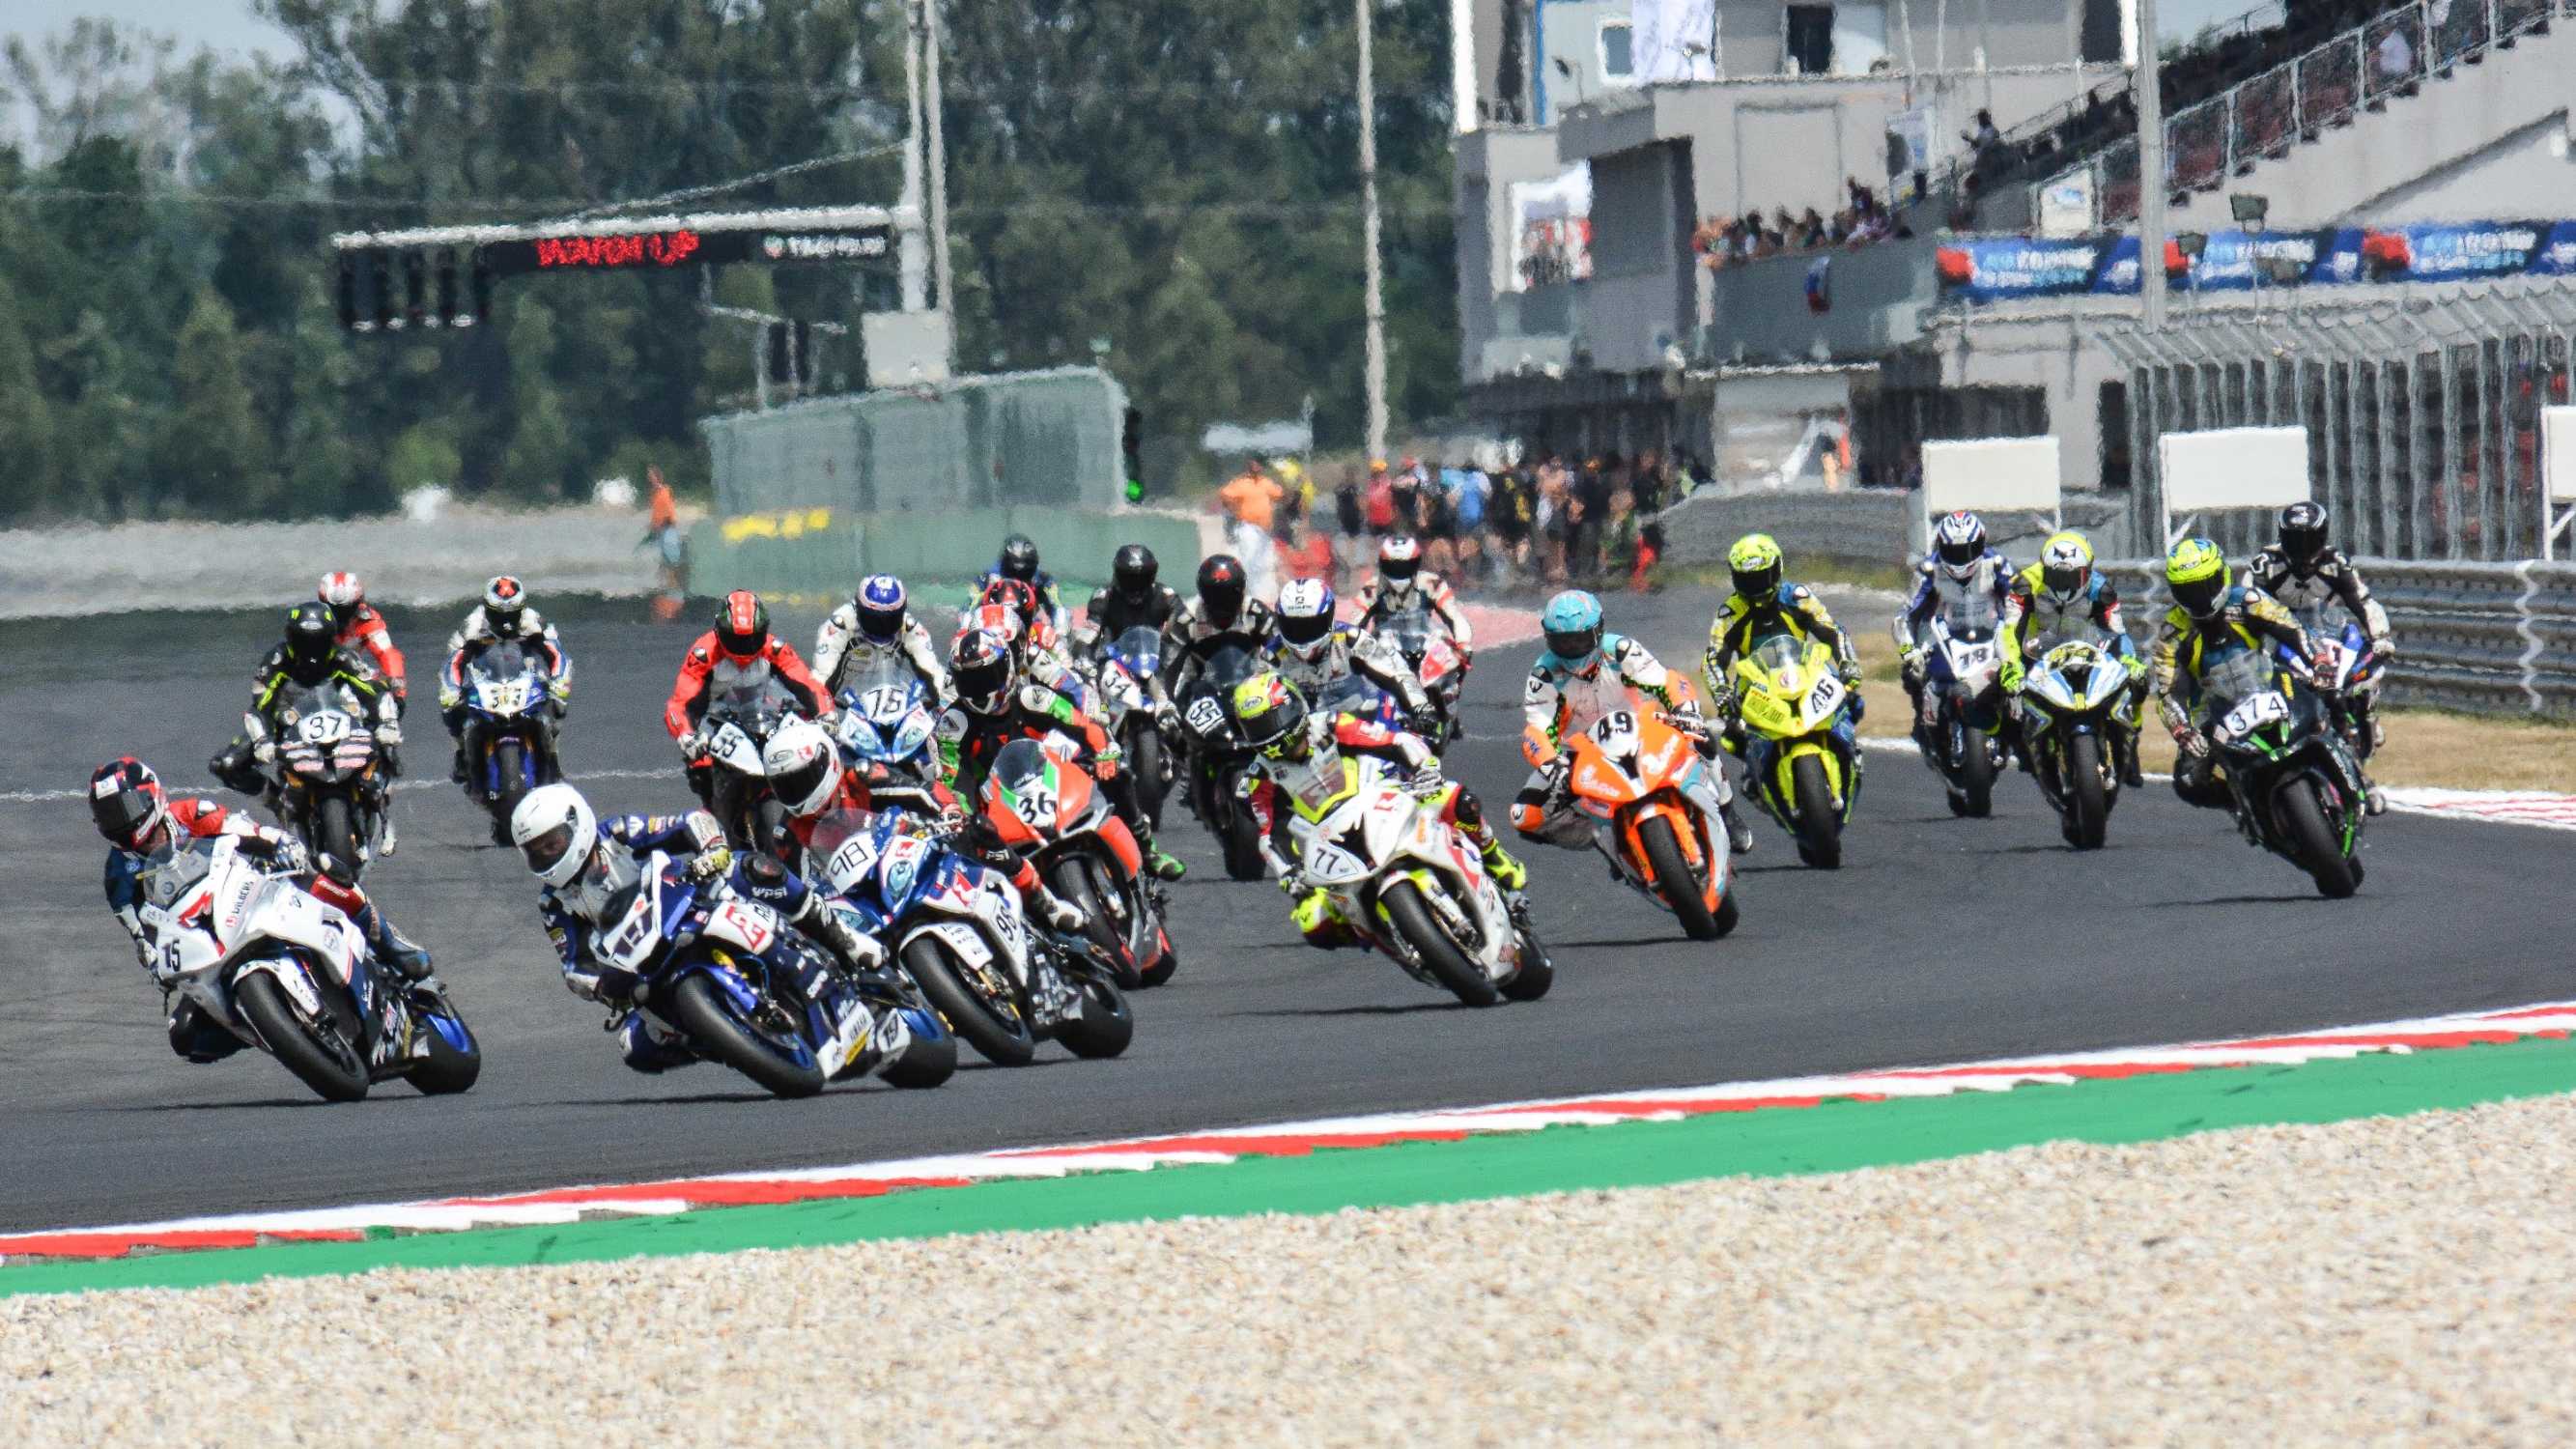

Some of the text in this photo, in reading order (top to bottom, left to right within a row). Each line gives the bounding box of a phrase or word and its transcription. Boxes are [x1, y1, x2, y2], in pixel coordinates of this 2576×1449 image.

[537, 228, 699, 267] WARM UP
[309, 714, 342, 740] 37
[1598, 711, 1633, 743] 49
[2231, 695, 2282, 731] 374
[1019, 791, 1058, 824] 36
[1314, 847, 1340, 875] 77
[162, 938, 182, 972] 15
